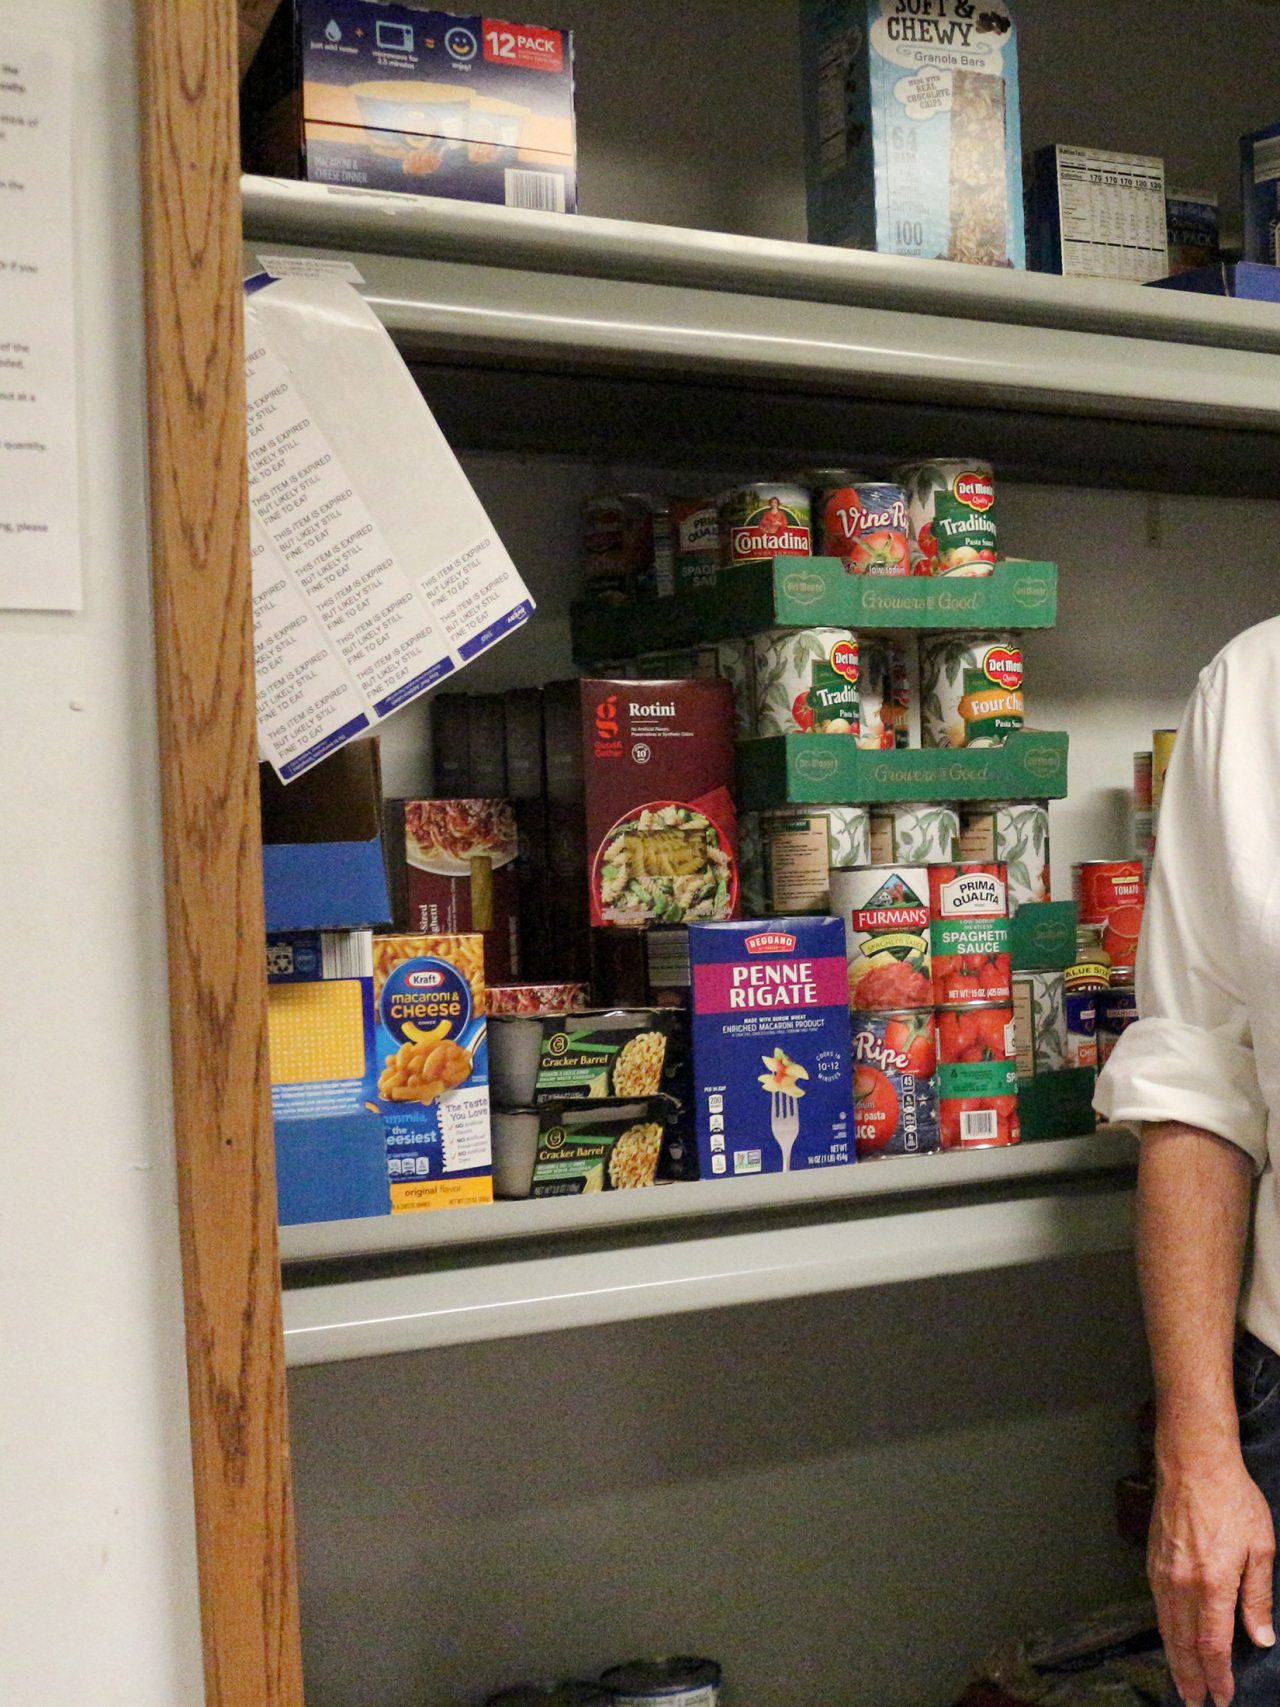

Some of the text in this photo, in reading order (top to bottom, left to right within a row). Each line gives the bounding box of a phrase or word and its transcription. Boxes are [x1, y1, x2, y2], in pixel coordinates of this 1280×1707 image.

[887, 17, 974, 46] CHEWY
[486, 31, 555, 58] 12 PACK
[914, 51, 985, 67] Granola Bars
[907, 88, 951, 103] CHOCOLATE
[916, 84, 937, 93] REAL
[919, 100, 942, 109] CHIPS
[1090, 174, 1102, 182] 170
[1105, 176, 1118, 184] 170
[1120, 178, 1133, 186] 170
[1135, 180, 1147, 188] 120
[1150, 182, 1162, 190] 120
[896, 220, 923, 246] 100
[253, 493, 269, 506] THIS
[270, 481, 288, 495] ITEM
[298, 454, 331, 478] EXPIRED
[258, 475, 319, 516] BUT LIKELY STILL
[959, 483, 974, 494] Del
[264, 495, 308, 525] FINE TO EAT
[837, 507, 891, 538] Vine
[735, 531, 808, 554] Contadina
[422, 576, 436, 589] THIS
[437, 565, 453, 578] ITEM
[461, 539, 491, 562] EXPIRED
[427, 558, 480, 599] BUT LIKELY STILL
[432, 578, 470, 607] FINE TO EAT
[862, 591, 978, 609] Growers Good
[835, 652, 848, 664] Del
[989, 659, 1004, 671] Del
[269, 684, 348, 739] THIS ITEM IS EXPIRED
[629, 702, 676, 716] Rotini
[971, 698, 1004, 715] Four
[274, 705, 336, 749] BUT LIKELY STILL
[279, 725, 323, 758] FINE TO EAT
[636, 750, 646, 758] 10
[874, 762, 988, 782] Growers Good
[960, 881, 996, 893] PRIMA
[953, 892, 1000, 907] QUALITA
[749, 936, 793, 948] REGGANO
[942, 930, 1008, 943] SPAGHETTI
[957, 942, 1000, 954] SAUCE
[414, 975, 436, 986] Kraft
[733, 963, 813, 986] PENNE
[391, 992, 459, 1004] macaroni &
[730, 984, 818, 1008] RIGATE
[949, 990, 958, 998] NET
[723, 1019, 825, 1033] ENRICHED MACARONI PRODUCT
[816, 1051, 834, 1061] COOKS
[856, 1031, 909, 1070] Ripe
[542, 1055, 608, 1067] Cracker Barrel
[818, 1061, 839, 1071] 10-12
[817, 1072, 842, 1082] MINUTES
[903, 1076, 913, 1086] 45
[446, 1098, 488, 1113] The Taste
[451, 1108, 488, 1121] You Love
[864, 1111, 886, 1122] pasta
[392, 1126, 407, 1134] the
[539, 1147, 604, 1160] Cracker Barrel
[405, 1185, 461, 1197] original flavor
